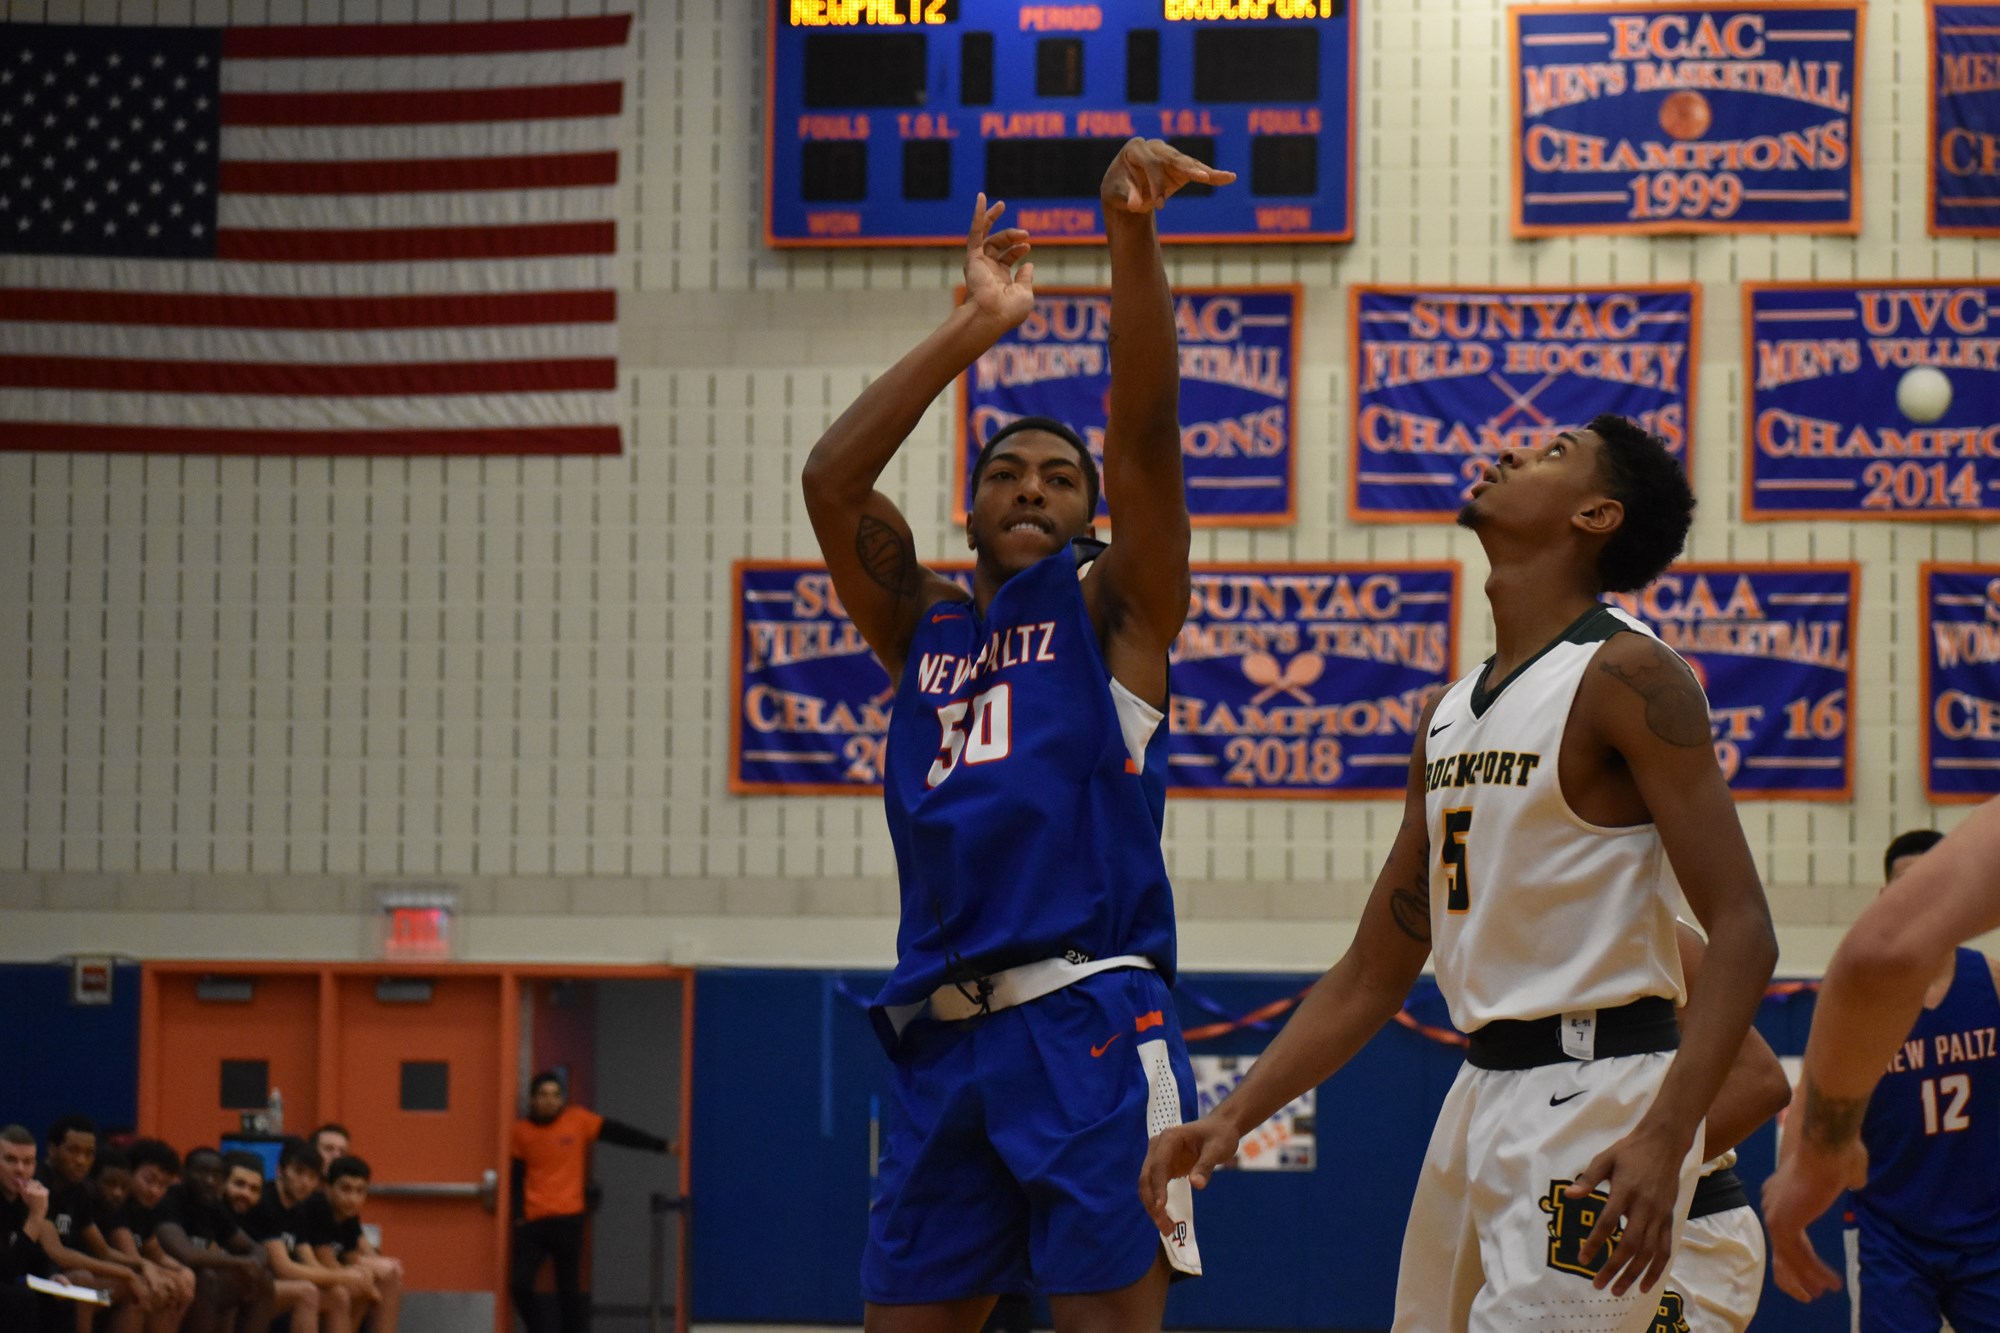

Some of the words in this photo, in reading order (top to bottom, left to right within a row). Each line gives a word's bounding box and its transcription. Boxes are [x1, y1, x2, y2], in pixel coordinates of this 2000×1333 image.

[1019, 6, 1102, 31] PERIOD
[1609, 14, 1766, 60] ECAC
[1524, 64, 1628, 117] MEN'S
[1633, 60, 1850, 113] BASKETBALL
[798, 114, 870, 139] FOULS
[980, 113, 1065, 137] PLAYER
[1077, 112, 1135, 136] FOUL
[1248, 110, 1322, 134] FOULS
[1525, 120, 1848, 172] CHAMPIONS
[1256, 207, 1311, 230] WON
[1627, 173, 1743, 218] 1999
[1018, 209, 1095, 232] MATCH
[1018, 297, 1242, 342] SUNAC
[1409, 294, 1642, 340] SUNYAC
[1856, 289, 1988, 335] UVC
[1360, 341, 1493, 393] FIELD
[1503, 342, 1685, 392] HOCKEY
[1757, 338, 1860, 390] MEN'S
[1861, 460, 1982, 510] 2014
[1308, 622, 1447, 674] TENNIS
[917, 652, 972, 695] NEW
[926, 682, 1012, 789] 50
[1784, 690, 1845, 740] 16
[1223, 736, 1343, 785] 2018
[1425, 750, 1541, 794] ROCKPORT
[1440, 806, 1473, 915] 5
[1887, 1038, 1925, 1073] EW
[1935, 1027, 1998, 1066] PALTZ
[1921, 1073, 1971, 1136] 12
